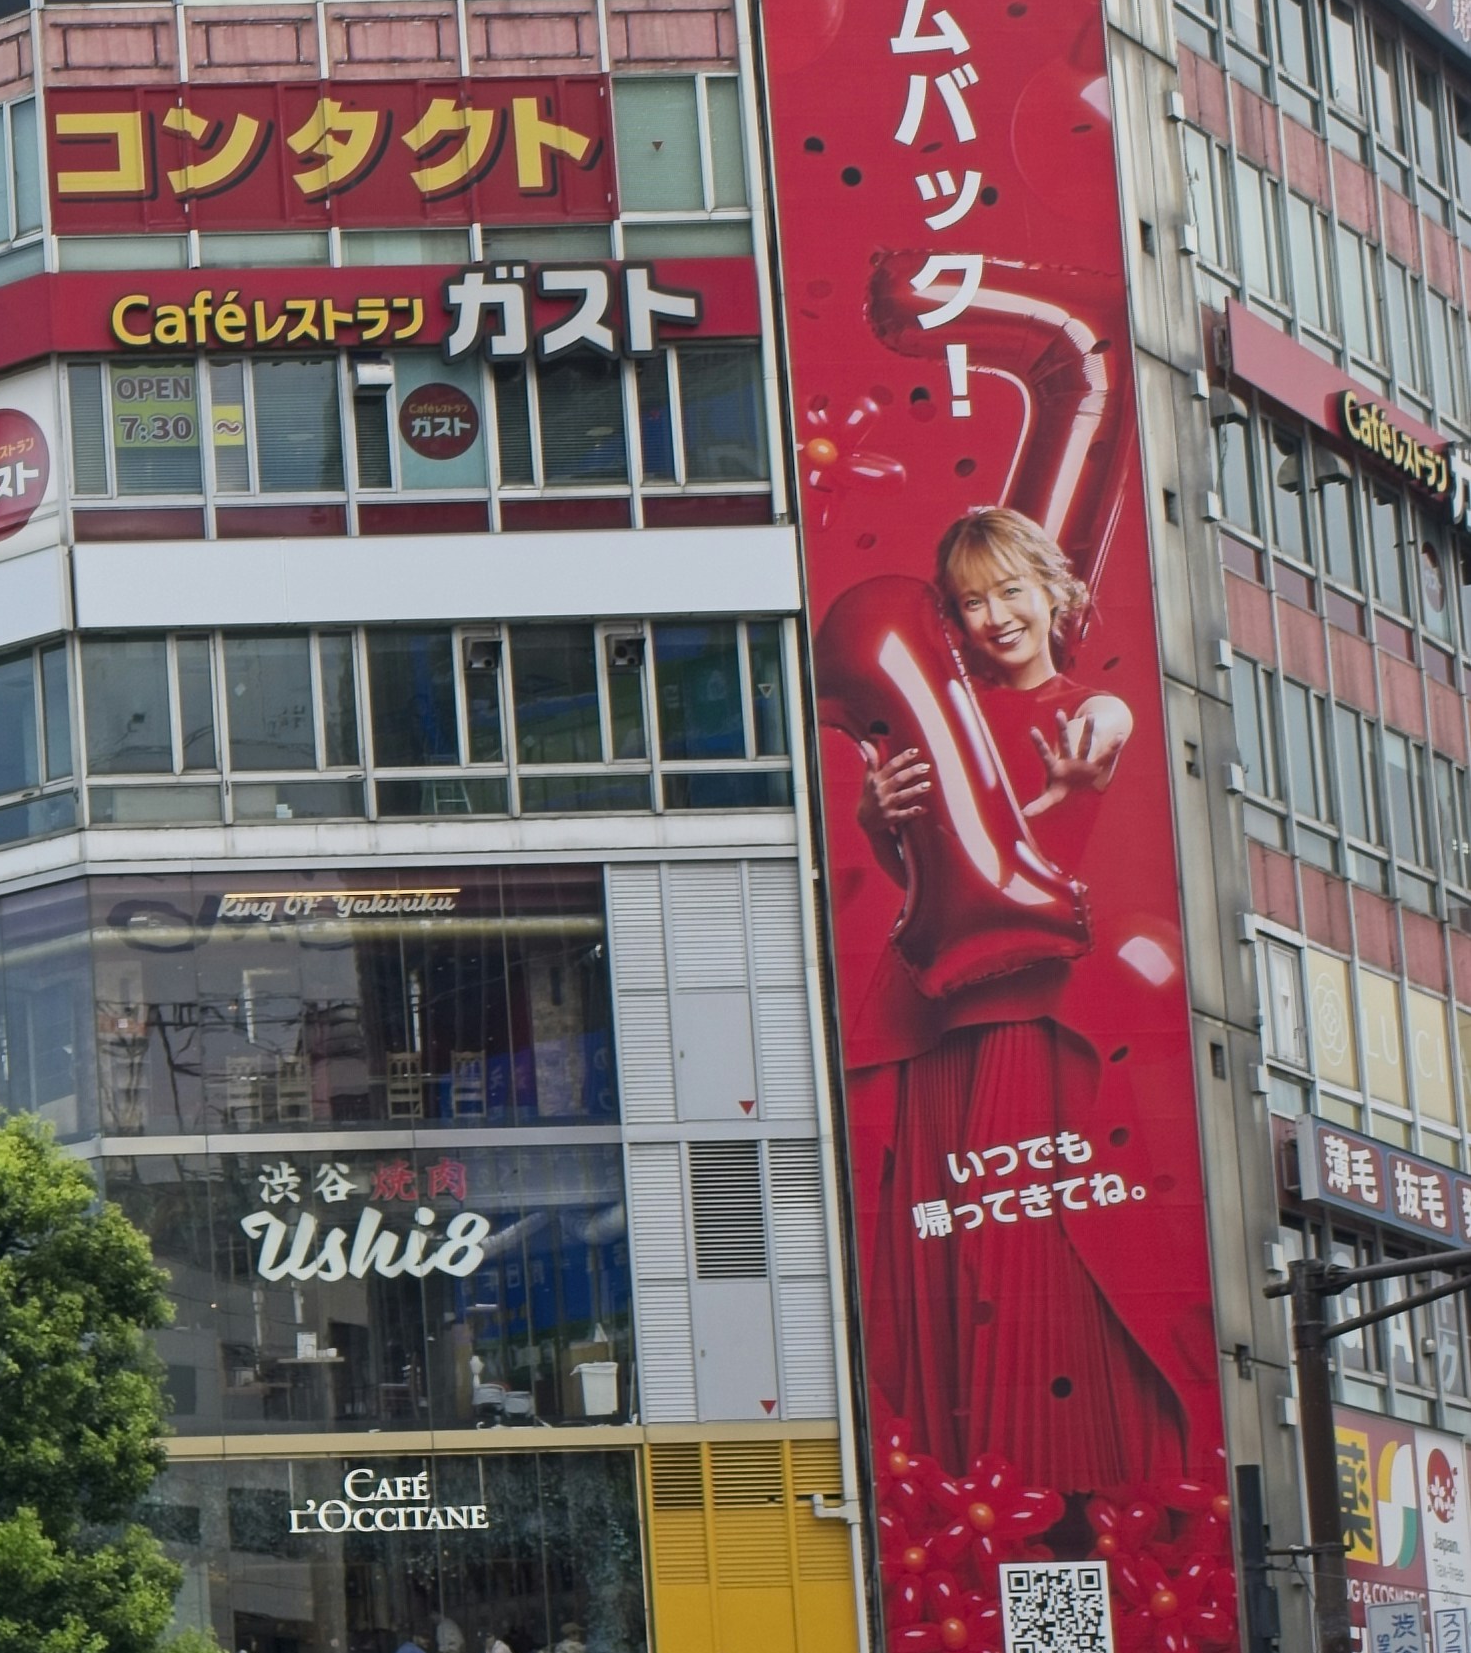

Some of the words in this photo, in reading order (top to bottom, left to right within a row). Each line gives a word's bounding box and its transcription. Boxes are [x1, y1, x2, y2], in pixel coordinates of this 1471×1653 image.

[54, 96, 593, 198] コンタクト
[445, 266, 699, 356] ガスト
[115, 375, 191, 402] OPEN
[410, 417, 472, 439] ガスト
[217, 896, 276, 922] King
[332, 894, 456, 918] Yakiniku
[947, 1130, 1093, 1186] いつでも
[1322, 1135, 1379, 1205] 薄毛
[1394, 1161, 1447, 1230] 抜毛
[913, 1171, 1148, 1241] 帰ってきてね。
[241, 1206, 492, 1282] Ushi8
[343, 1469, 430, 1504] CAFÉ
